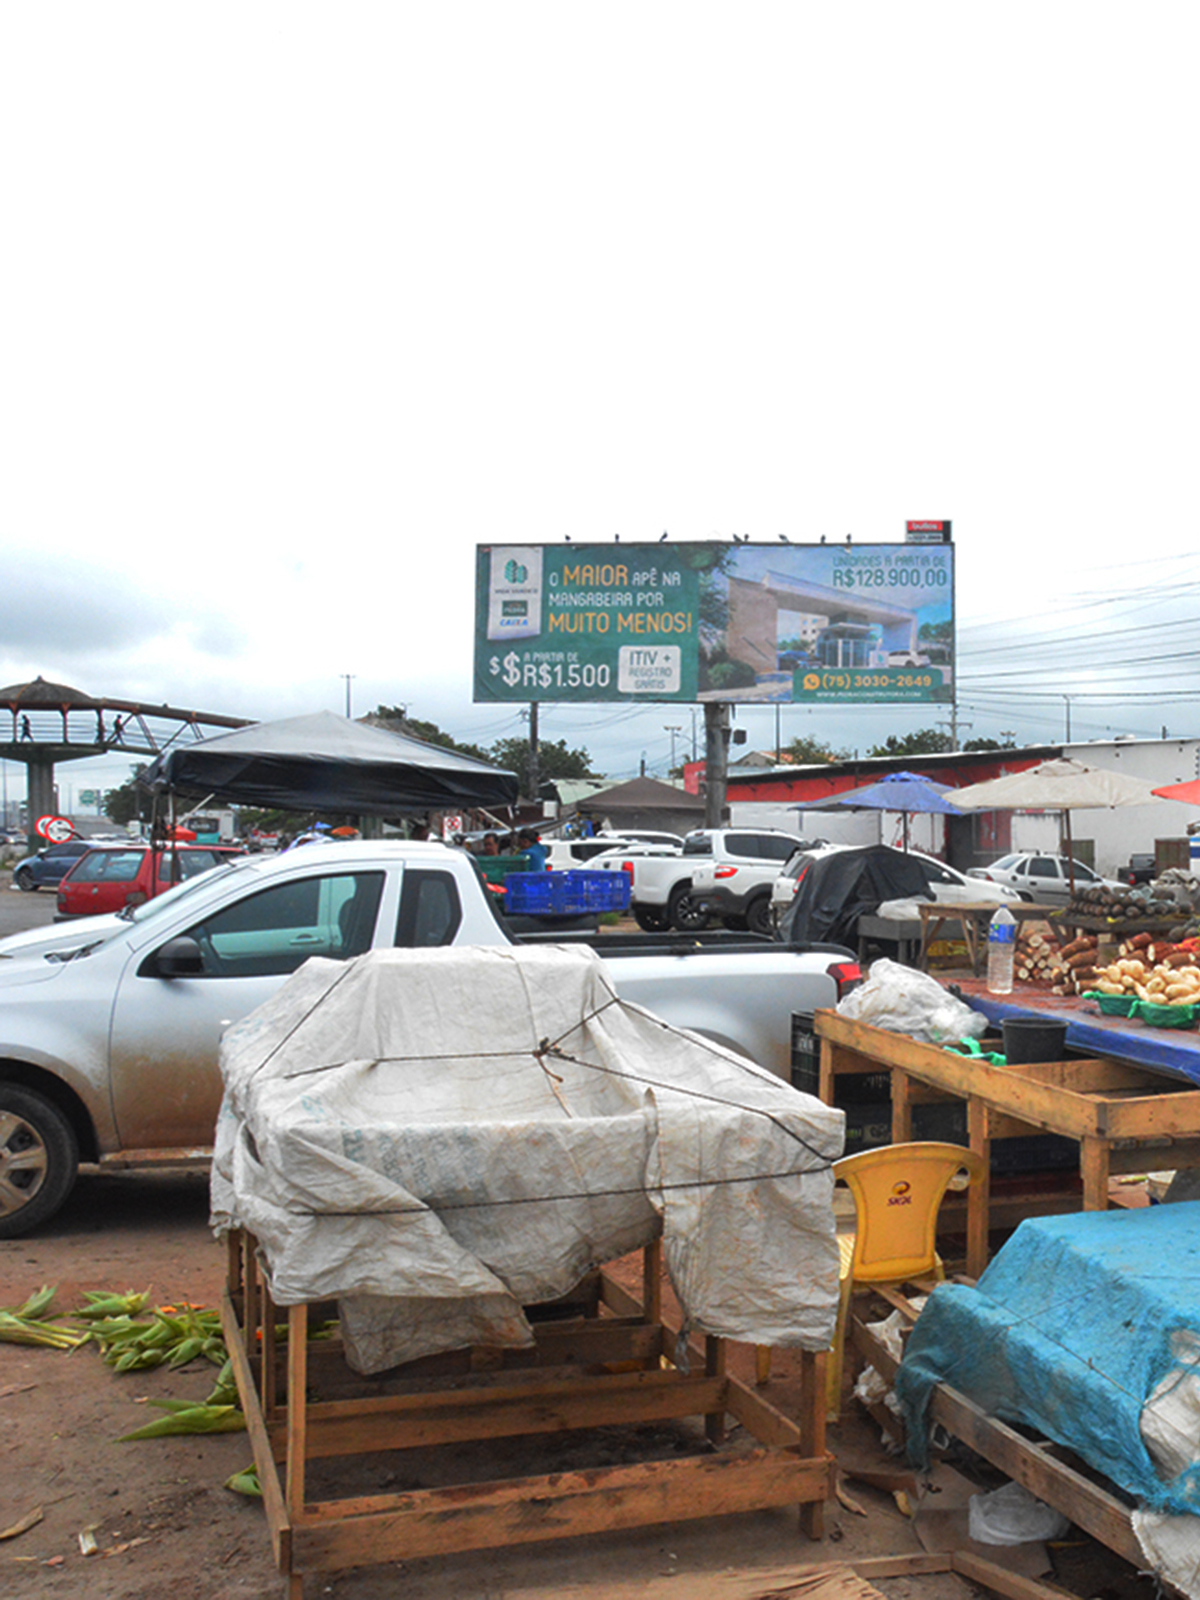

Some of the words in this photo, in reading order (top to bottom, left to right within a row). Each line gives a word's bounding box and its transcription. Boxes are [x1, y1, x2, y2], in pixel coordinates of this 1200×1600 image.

[833, 555, 882, 567] UNIDADES
[895, 555, 930, 567] PARTIR
[549, 572, 559, 587] O
[563, 564, 628, 586] MAIOR
[631, 566, 657, 587] APÊ
[662, 571, 681, 586] NA
[833, 568, 947, 588] R$128.900,00
[548, 592, 633, 607] MANGABEIRA
[636, 592, 664, 607] POR
[549, 612, 610, 633] MUITO
[617, 612, 692, 633] MENOS!
[533, 652, 565, 662] PARTIR
[630, 650, 658, 665] ITIV
[523, 663, 610, 688] R$1.500
[822, 673, 851, 690] (75)
[854, 675, 932, 688] 3030-2649
